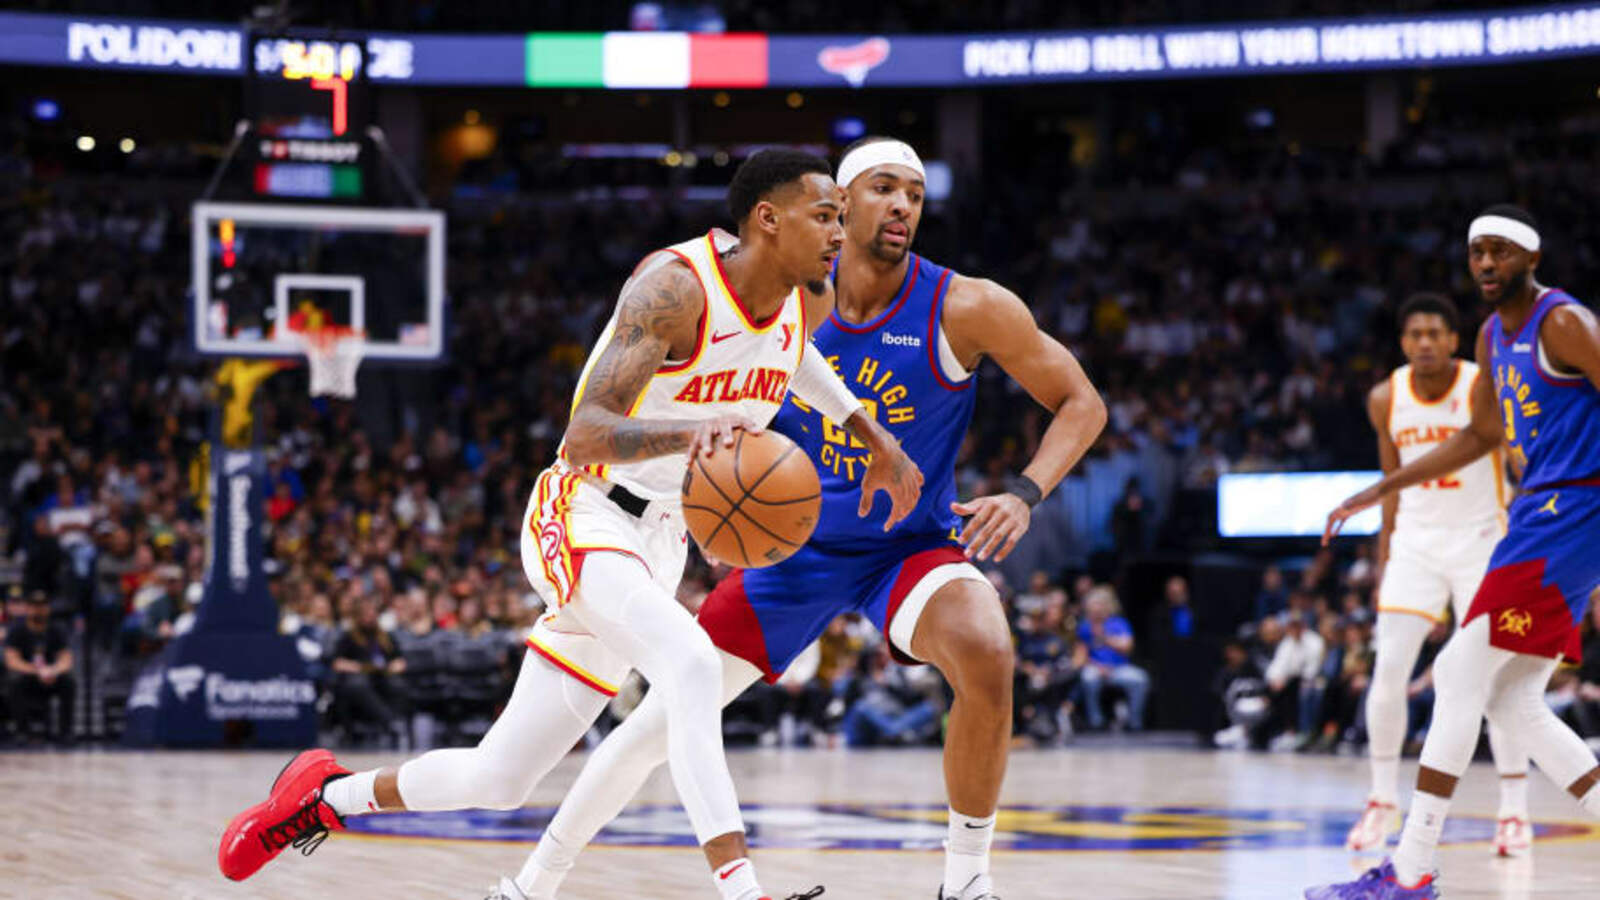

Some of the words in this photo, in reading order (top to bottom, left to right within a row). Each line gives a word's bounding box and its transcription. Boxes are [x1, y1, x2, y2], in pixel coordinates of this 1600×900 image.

[68, 23, 241, 69] POLIDORI
[963, 40, 1031, 76] PICK
[1031, 37, 1091, 74] AND
[1092, 35, 1164, 72] ROLL
[1164, 31, 1240, 68] WITH
[1241, 28, 1318, 65] YOUR
[1320, 21, 1485, 62] HOMETOWN
[882, 332, 920, 346] ibotta
[856, 357, 915, 424] HIGH
[820, 444, 873, 481] CITY
